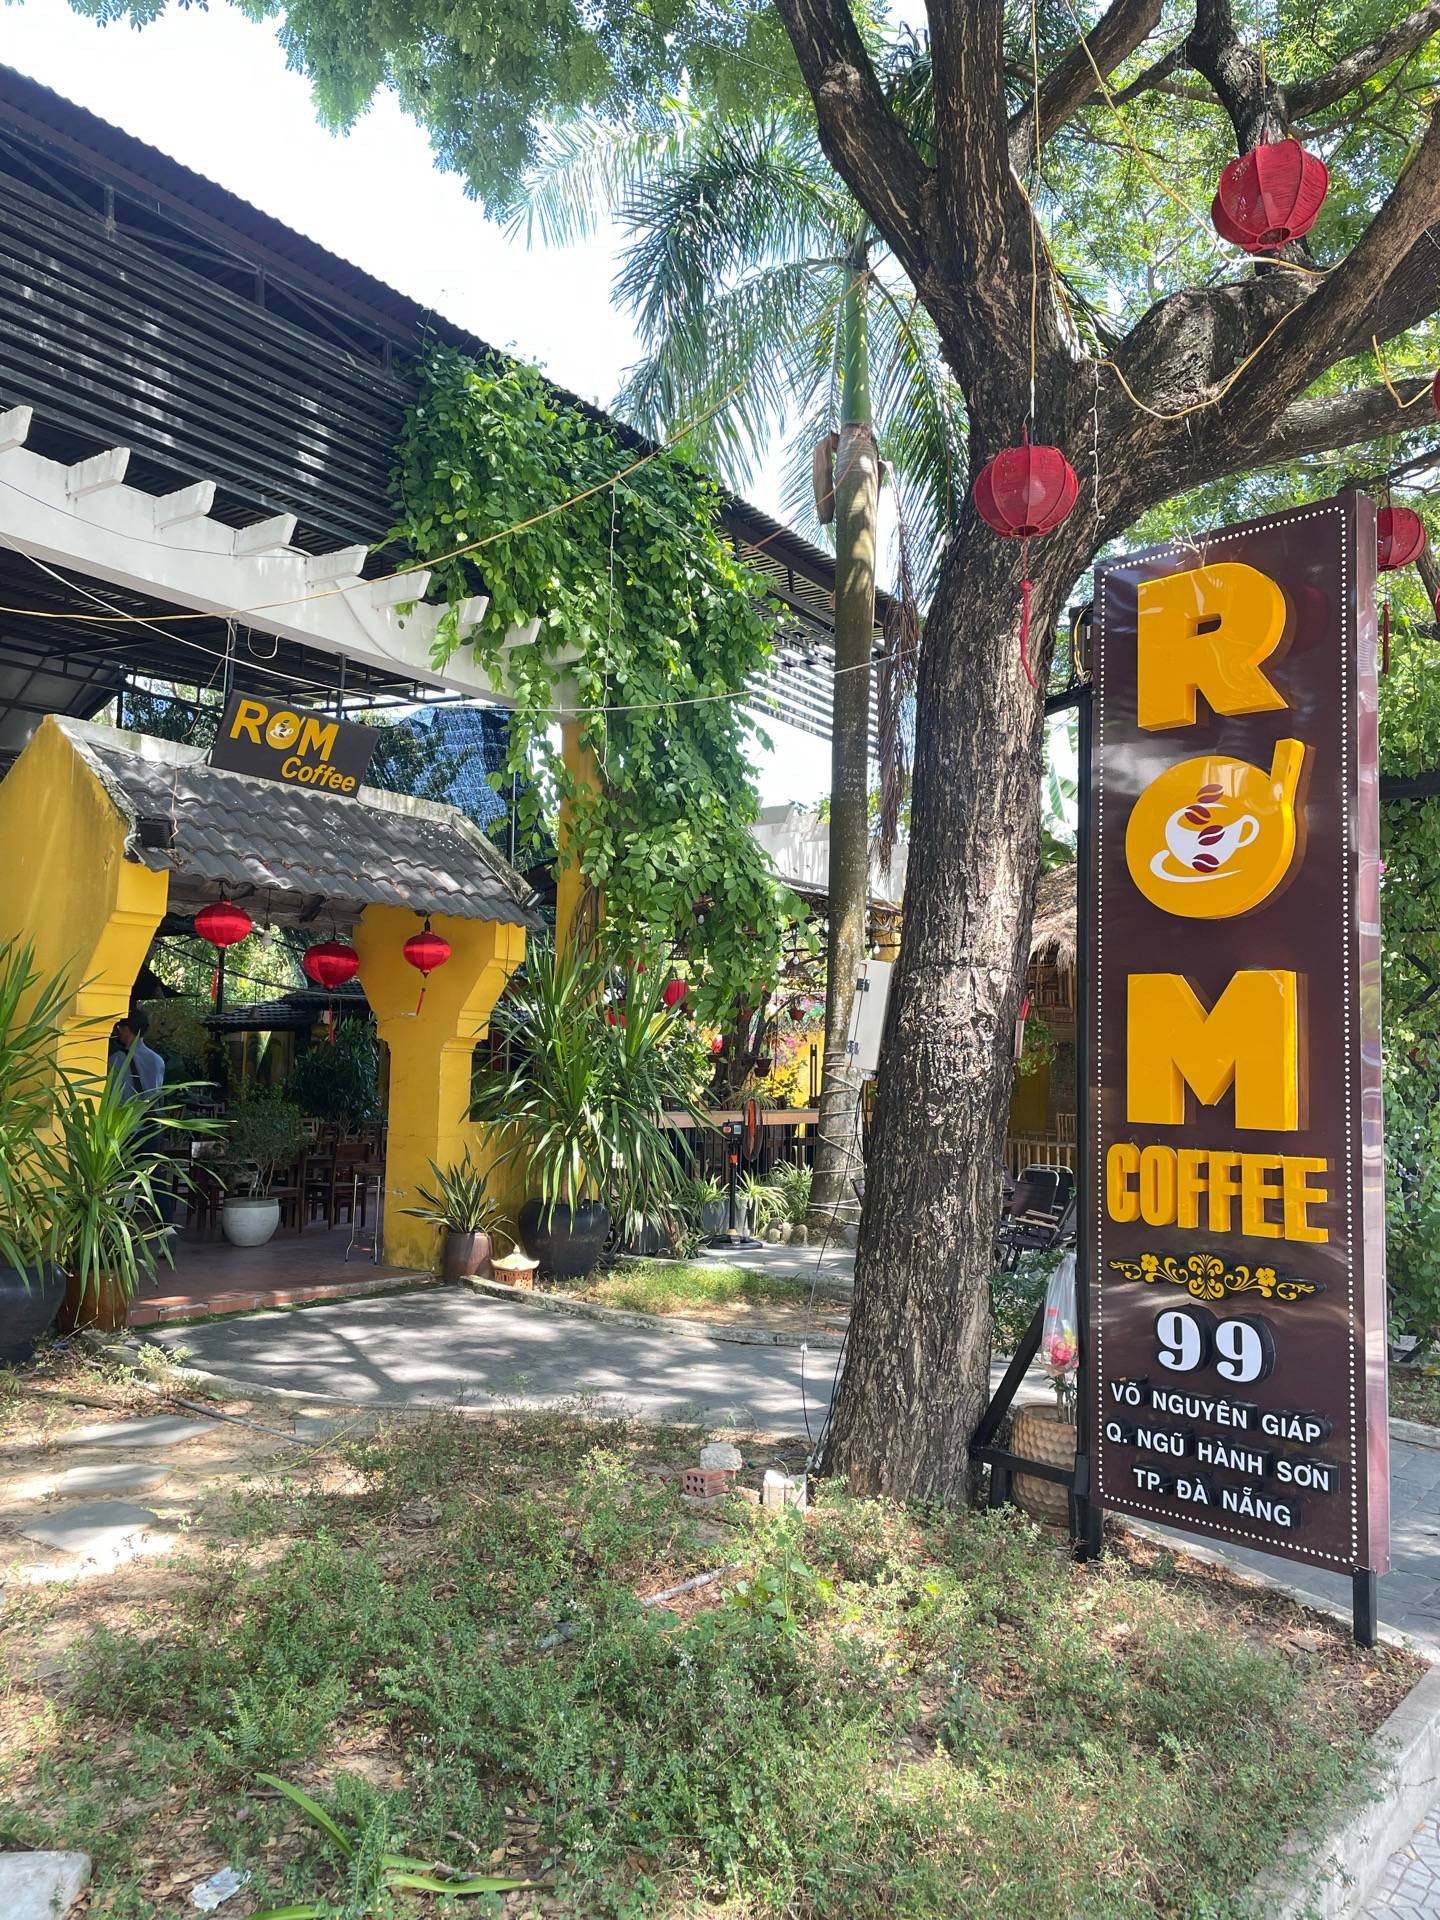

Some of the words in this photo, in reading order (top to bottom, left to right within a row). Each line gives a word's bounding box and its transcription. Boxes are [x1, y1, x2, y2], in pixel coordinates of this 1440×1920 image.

[281, 756, 356, 792] Coffee
[1106, 1143, 1329, 1243] COFFEE
[1156, 1310, 1264, 1382] 99
[1111, 1382, 1141, 1406] VÕ
[1152, 1390, 1248, 1430] NGUYÊN
[1261, 1414, 1321, 1443] GIÁP
[1106, 1422, 1128, 1444] Q.
[1137, 1428, 1185, 1457] NGŨ
[1197, 1440, 1263, 1476] HÀNH
[1276, 1460, 1329, 1491] SƠN
[1133, 1468, 1164, 1493] TP.
[1176, 1478, 1208, 1505] ĐÀ
[1222, 1486, 1292, 1527] NẴNG
